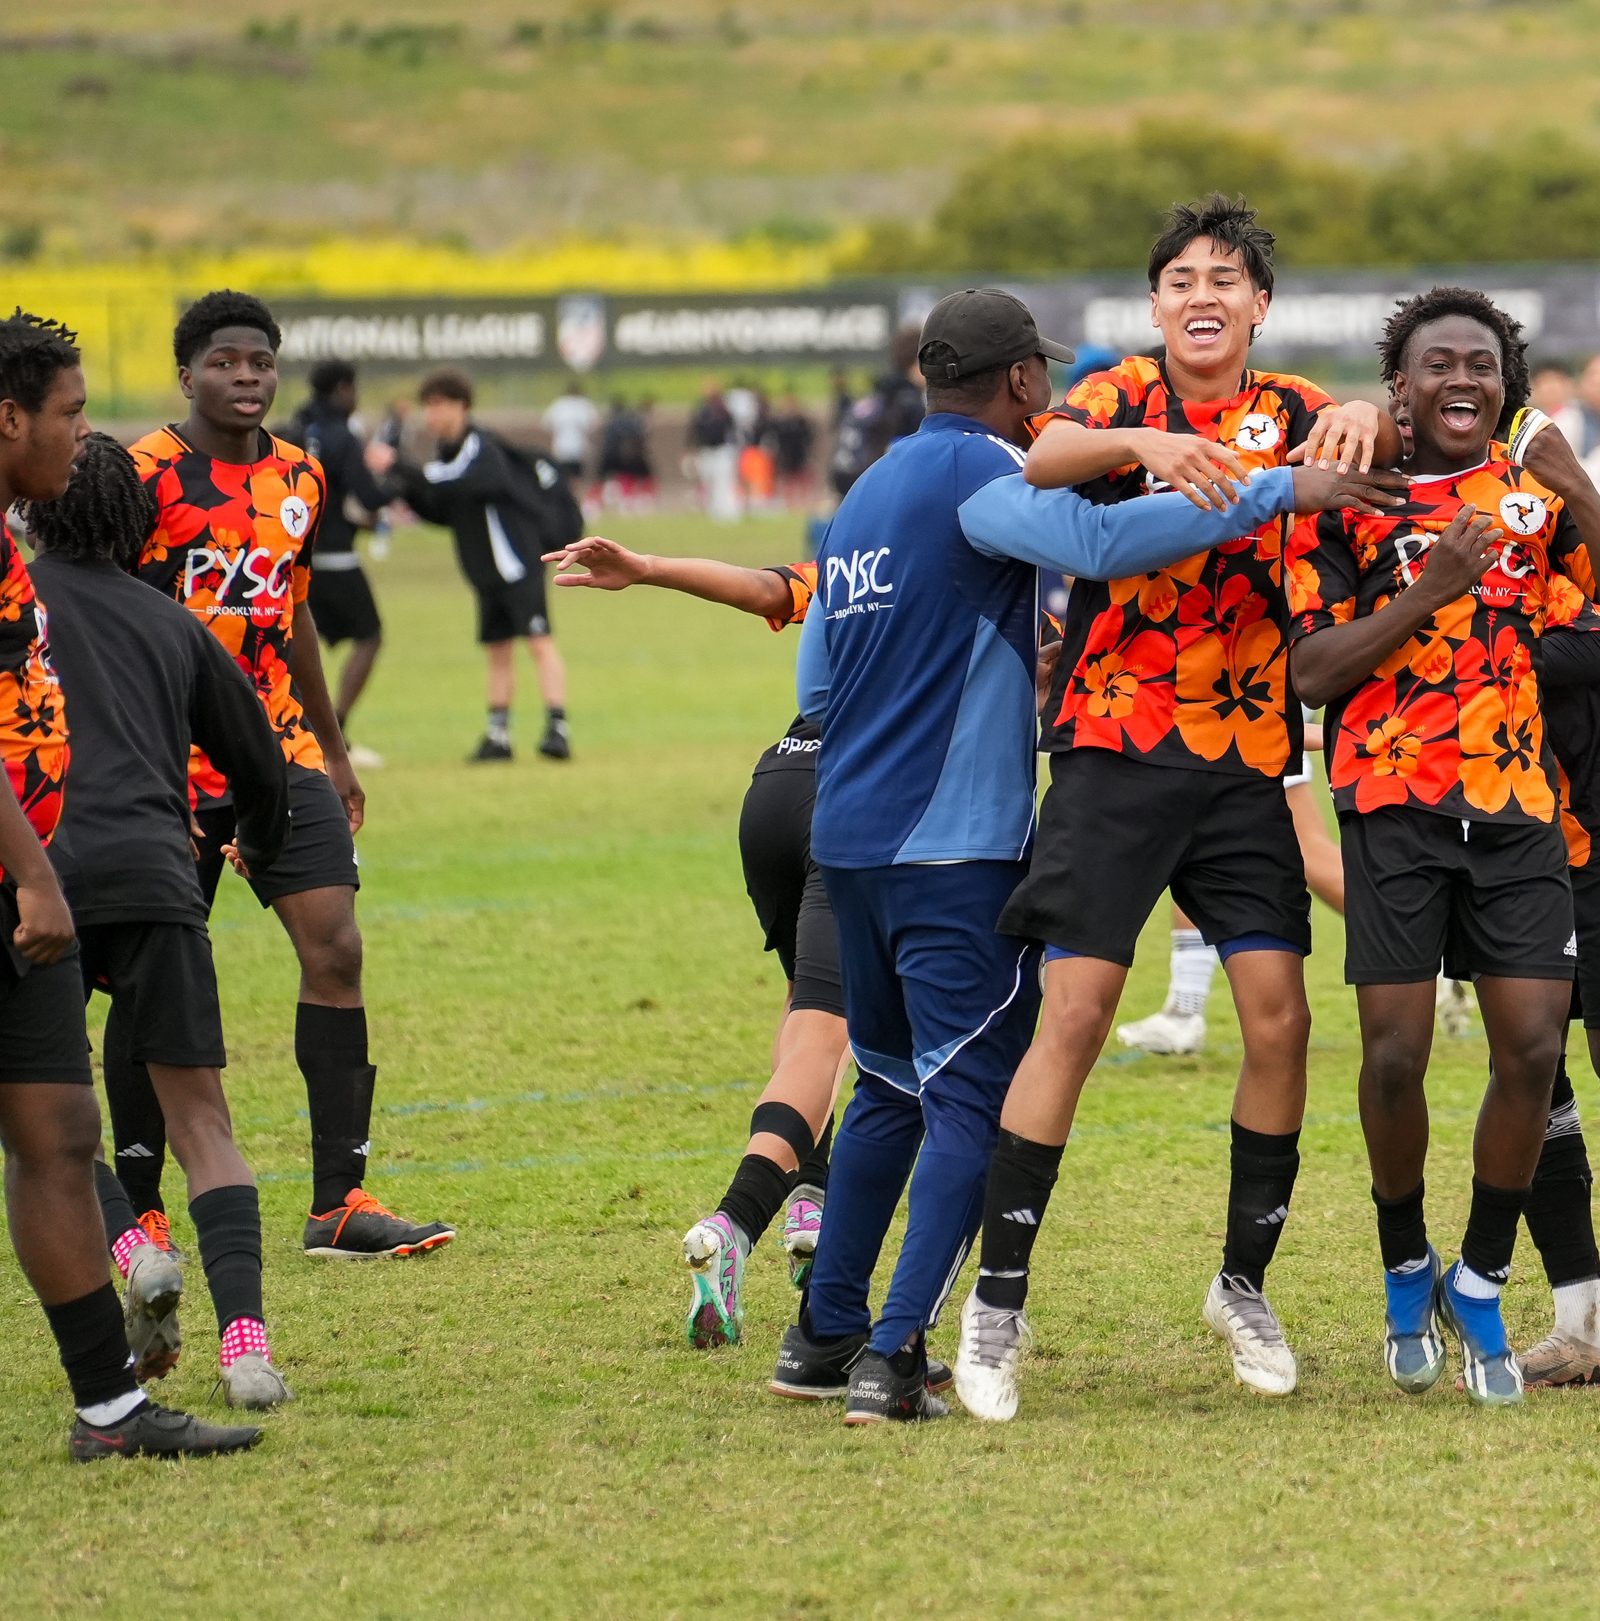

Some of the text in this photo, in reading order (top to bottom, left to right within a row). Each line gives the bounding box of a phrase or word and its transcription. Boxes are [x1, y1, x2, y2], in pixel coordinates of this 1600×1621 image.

[279, 314, 421, 361] ATIONAL
[183, 547, 294, 601] PYSC
[826, 547, 893, 608] PYSC
[1495, 586, 1511, 597] NY
[206, 605, 276, 617] BROOKLYN, NY
[867, 602, 880, 611] NY
[858, 1379, 880, 1390] new
[849, 1388, 888, 1401] balance
